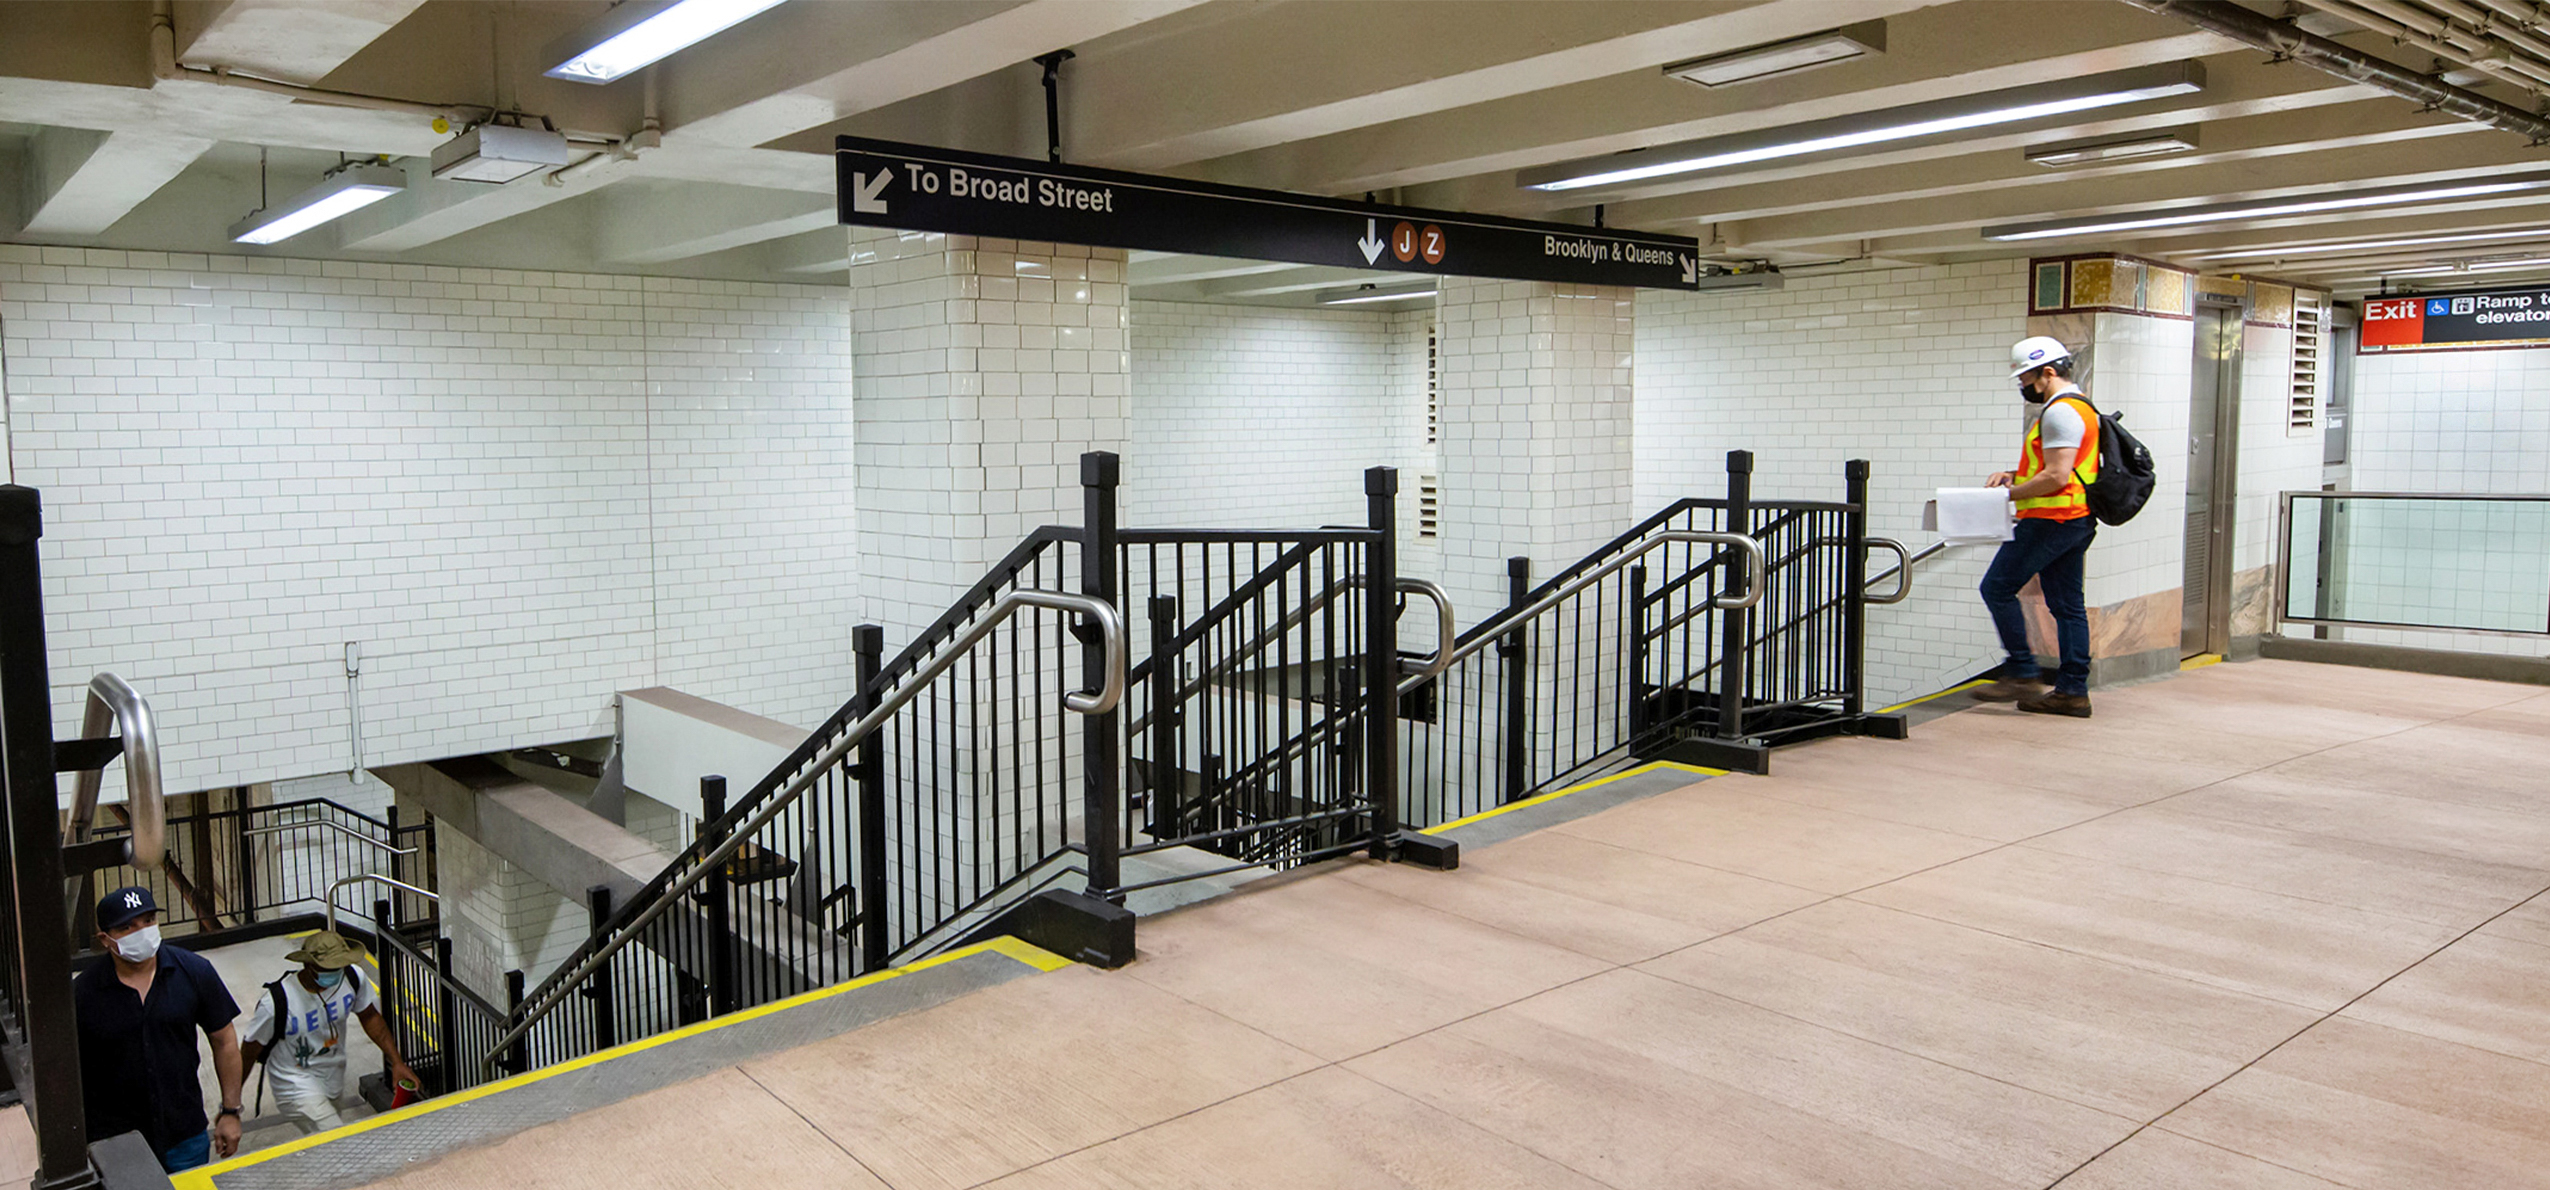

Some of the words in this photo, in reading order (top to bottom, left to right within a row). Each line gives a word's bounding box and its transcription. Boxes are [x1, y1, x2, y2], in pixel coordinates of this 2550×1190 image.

[905, 163, 940, 194] To
[950, 168, 1030, 205] Broad
[1038, 178, 1113, 213] Street
[1400, 230, 1411, 254] J
[1427, 233, 1439, 256] Z
[1544, 235, 1608, 265] Brooklyn
[1611, 242, 1622, 261] &
[1625, 243, 1674, 266] Queens
[2365, 301, 2417, 321] Exit
[2476, 295, 2533, 309] Ramp
[2540, 293, 2550, 306] t
[123, 891, 143, 909] NY
[286, 993, 354, 1036] JEEP
